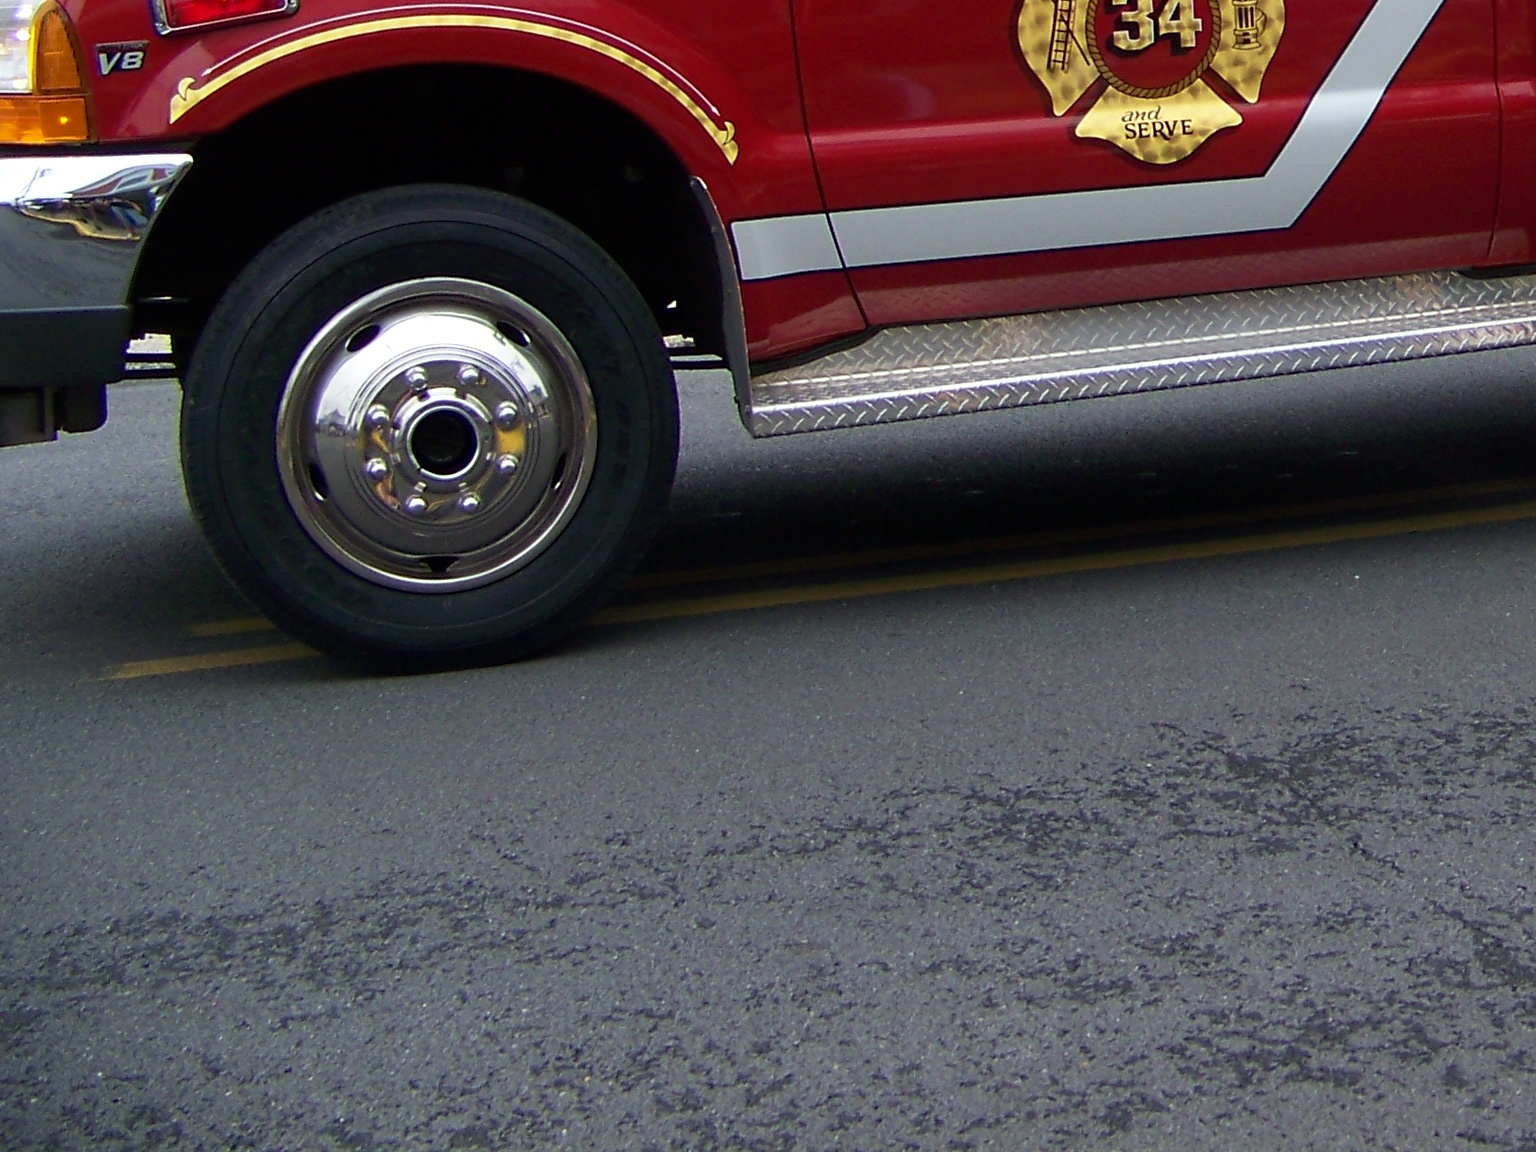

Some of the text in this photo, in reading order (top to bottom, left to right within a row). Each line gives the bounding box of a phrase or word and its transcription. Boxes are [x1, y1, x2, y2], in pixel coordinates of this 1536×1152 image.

[98, 50, 145, 76] V8
[1120, 105, 1162, 123] and
[1124, 118, 1195, 141] SERVE
